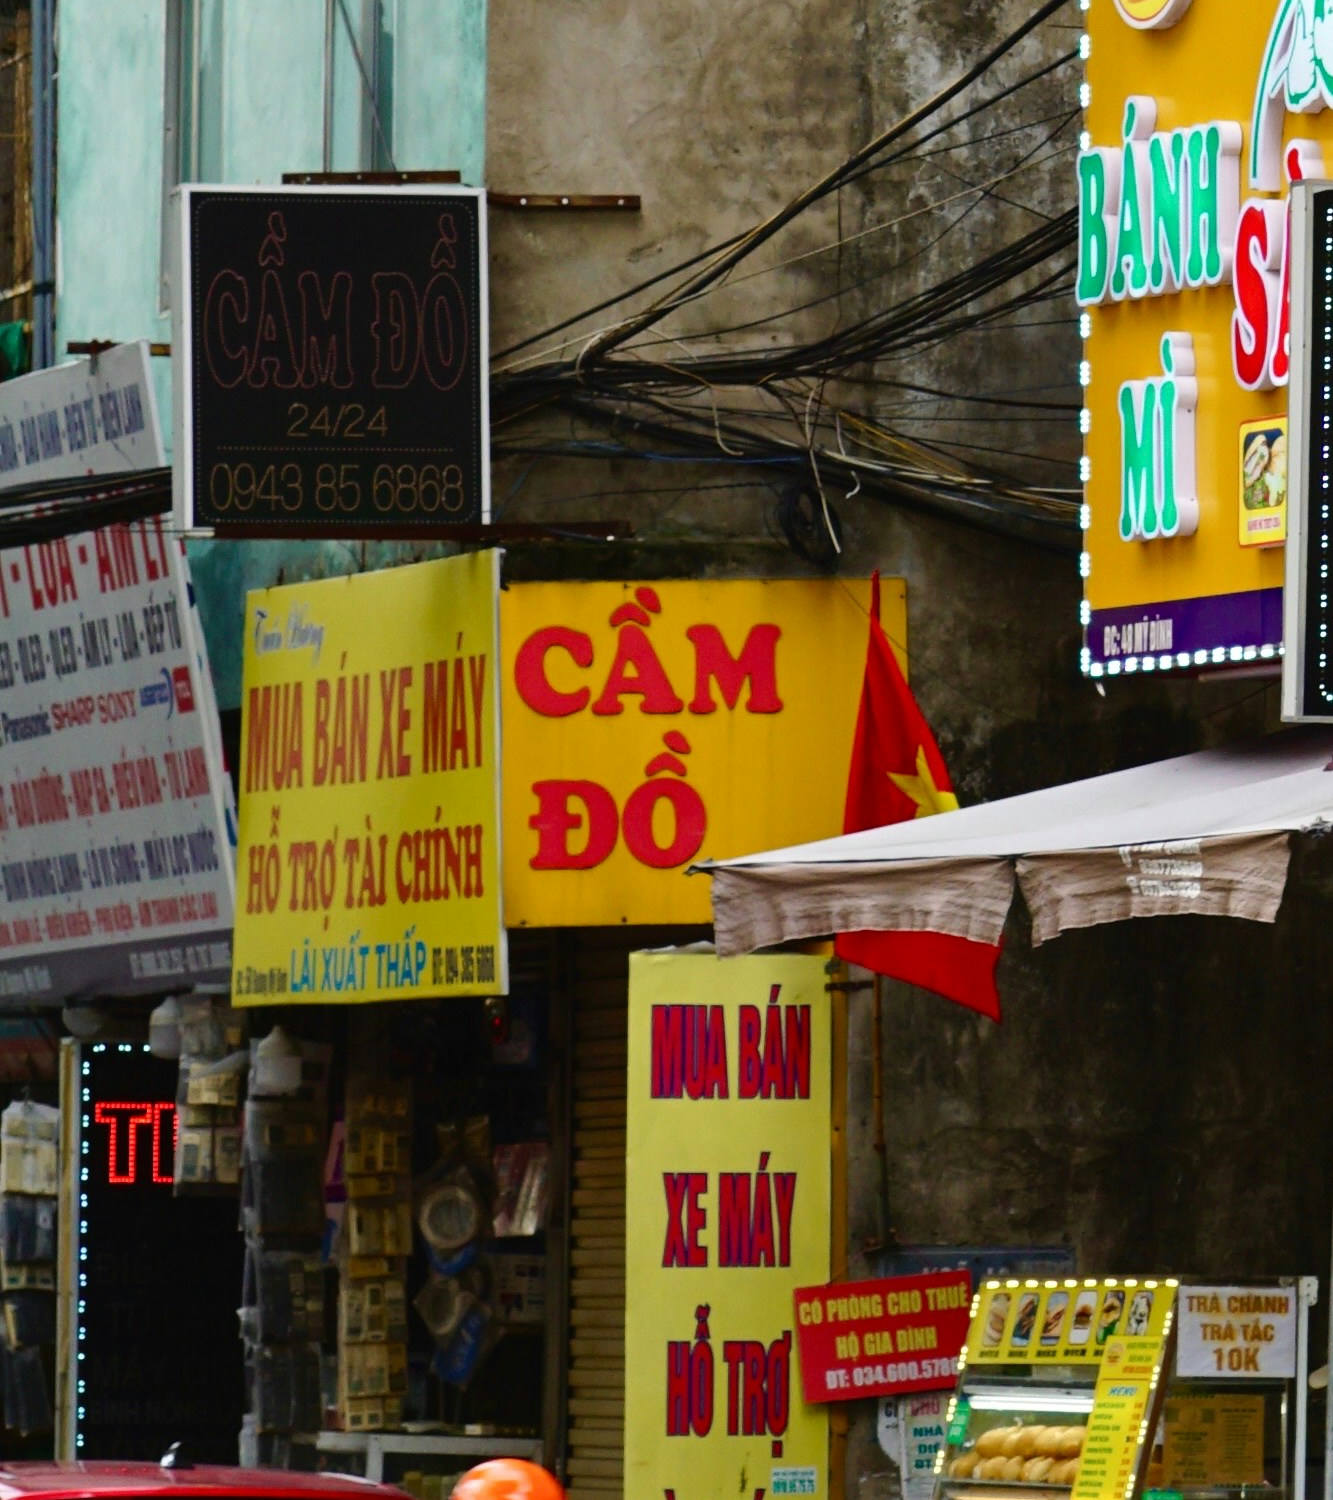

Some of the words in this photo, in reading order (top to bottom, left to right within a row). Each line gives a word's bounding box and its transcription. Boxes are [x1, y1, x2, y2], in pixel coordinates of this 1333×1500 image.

[287, 402, 388, 438] 24/24
[210, 463, 302, 511] 0943
[315, 463, 361, 511] 85
[372, 463, 464, 512] 6868
[515, 586, 783, 718] CẦM
[51, 695, 95, 731] SHARP
[97, 689, 137, 724] SONY
[246, 681, 303, 794] MUA
[313, 650, 370, 787] BÁN
[376, 667, 413, 781] XE
[422, 632, 487, 775] MÁY
[528, 730, 707, 870] ĐỒ
[395, 806, 485, 906] CHÍNH
[322, 929, 370, 992] XUẤT
[376, 923, 427, 990] THẤP
[651, 1004, 729, 1100] MUA
[738, 984, 811, 1100] BÁN
[662, 1172, 708, 1268] XE
[718, 1152, 796, 1268] MÁY
[800, 1296, 823, 1326] CÓ
[828, 1291, 883, 1322] PHÒNG
[888, 1289, 923, 1317] CHO
[926, 1281, 969, 1312] THUÊ
[1186, 1291, 1227, 1314] TRÀ
[1230, 1295, 1289, 1315] CHANH
[1200, 1319, 1237, 1342] TRÀ
[836, 1332, 859, 1362] HỘ
[864, 1329, 893, 1357] GIA
[896, 1325, 937, 1353] ĐÌNH
[1212, 1347, 1260, 1373] 10K
[666, 1304, 714, 1437] HỖ
[723, 1330, 791, 1458] TRỢ
